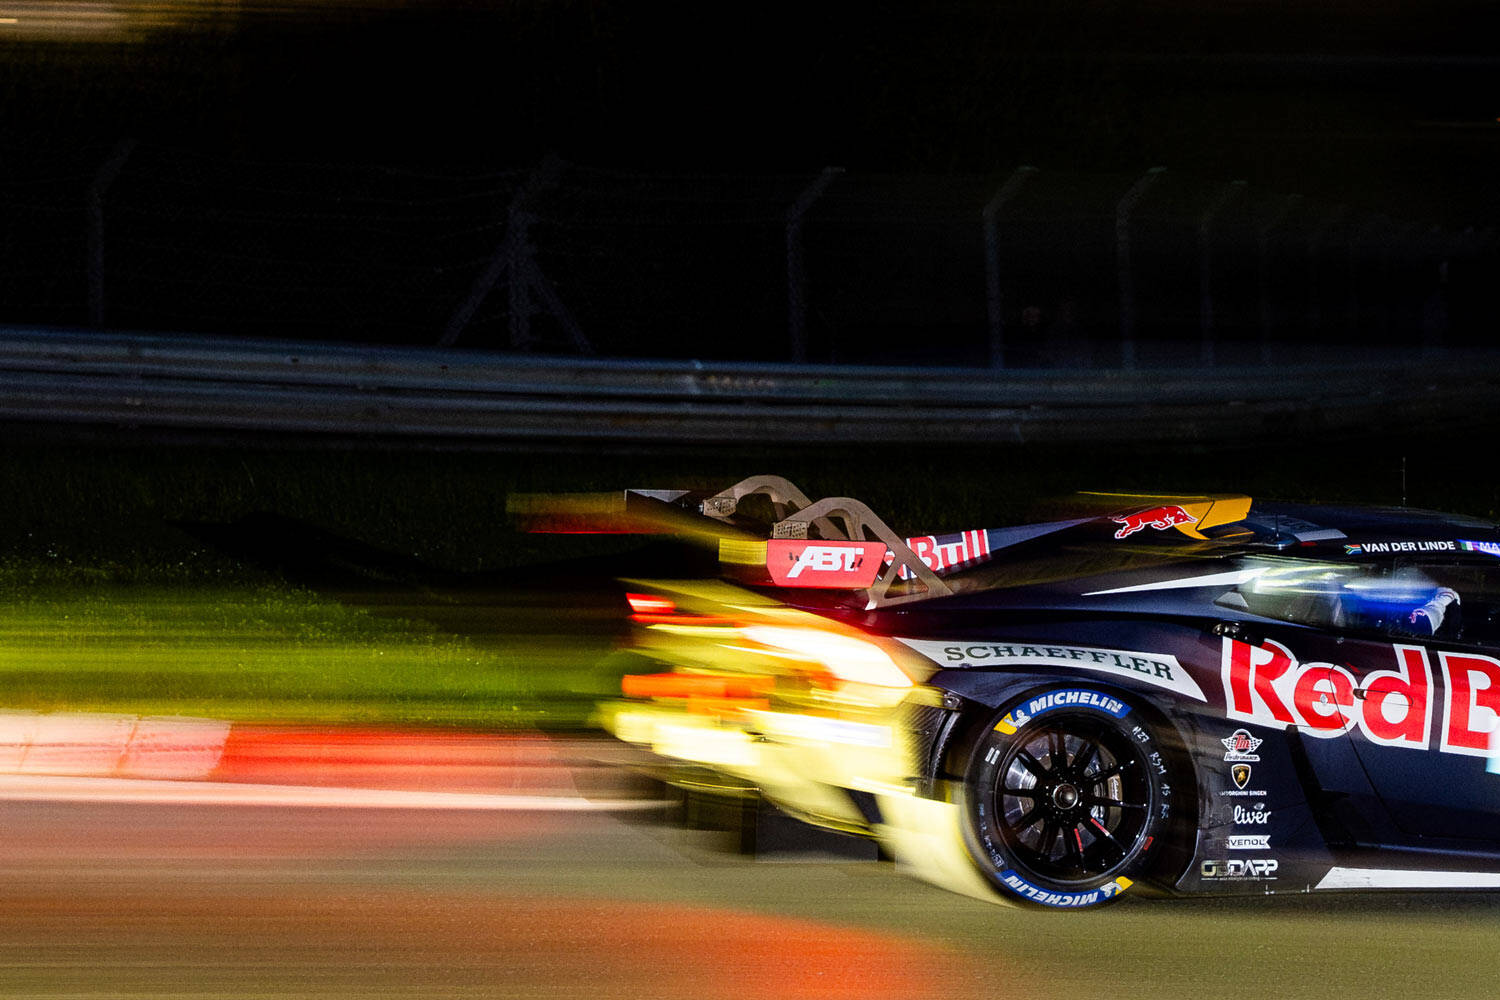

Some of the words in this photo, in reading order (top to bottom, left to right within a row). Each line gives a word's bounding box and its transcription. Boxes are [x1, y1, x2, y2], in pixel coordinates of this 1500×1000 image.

[786, 546, 864, 578] ABT
[1361, 543, 1390, 552] VAN
[1390, 542, 1417, 551] DER
[1417, 541, 1456, 551] LINDE
[943, 645, 1176, 681] SCHAEFFLER
[1029, 691, 1123, 715] MICHELIN
[1004, 875, 1098, 906] MICHELIN
